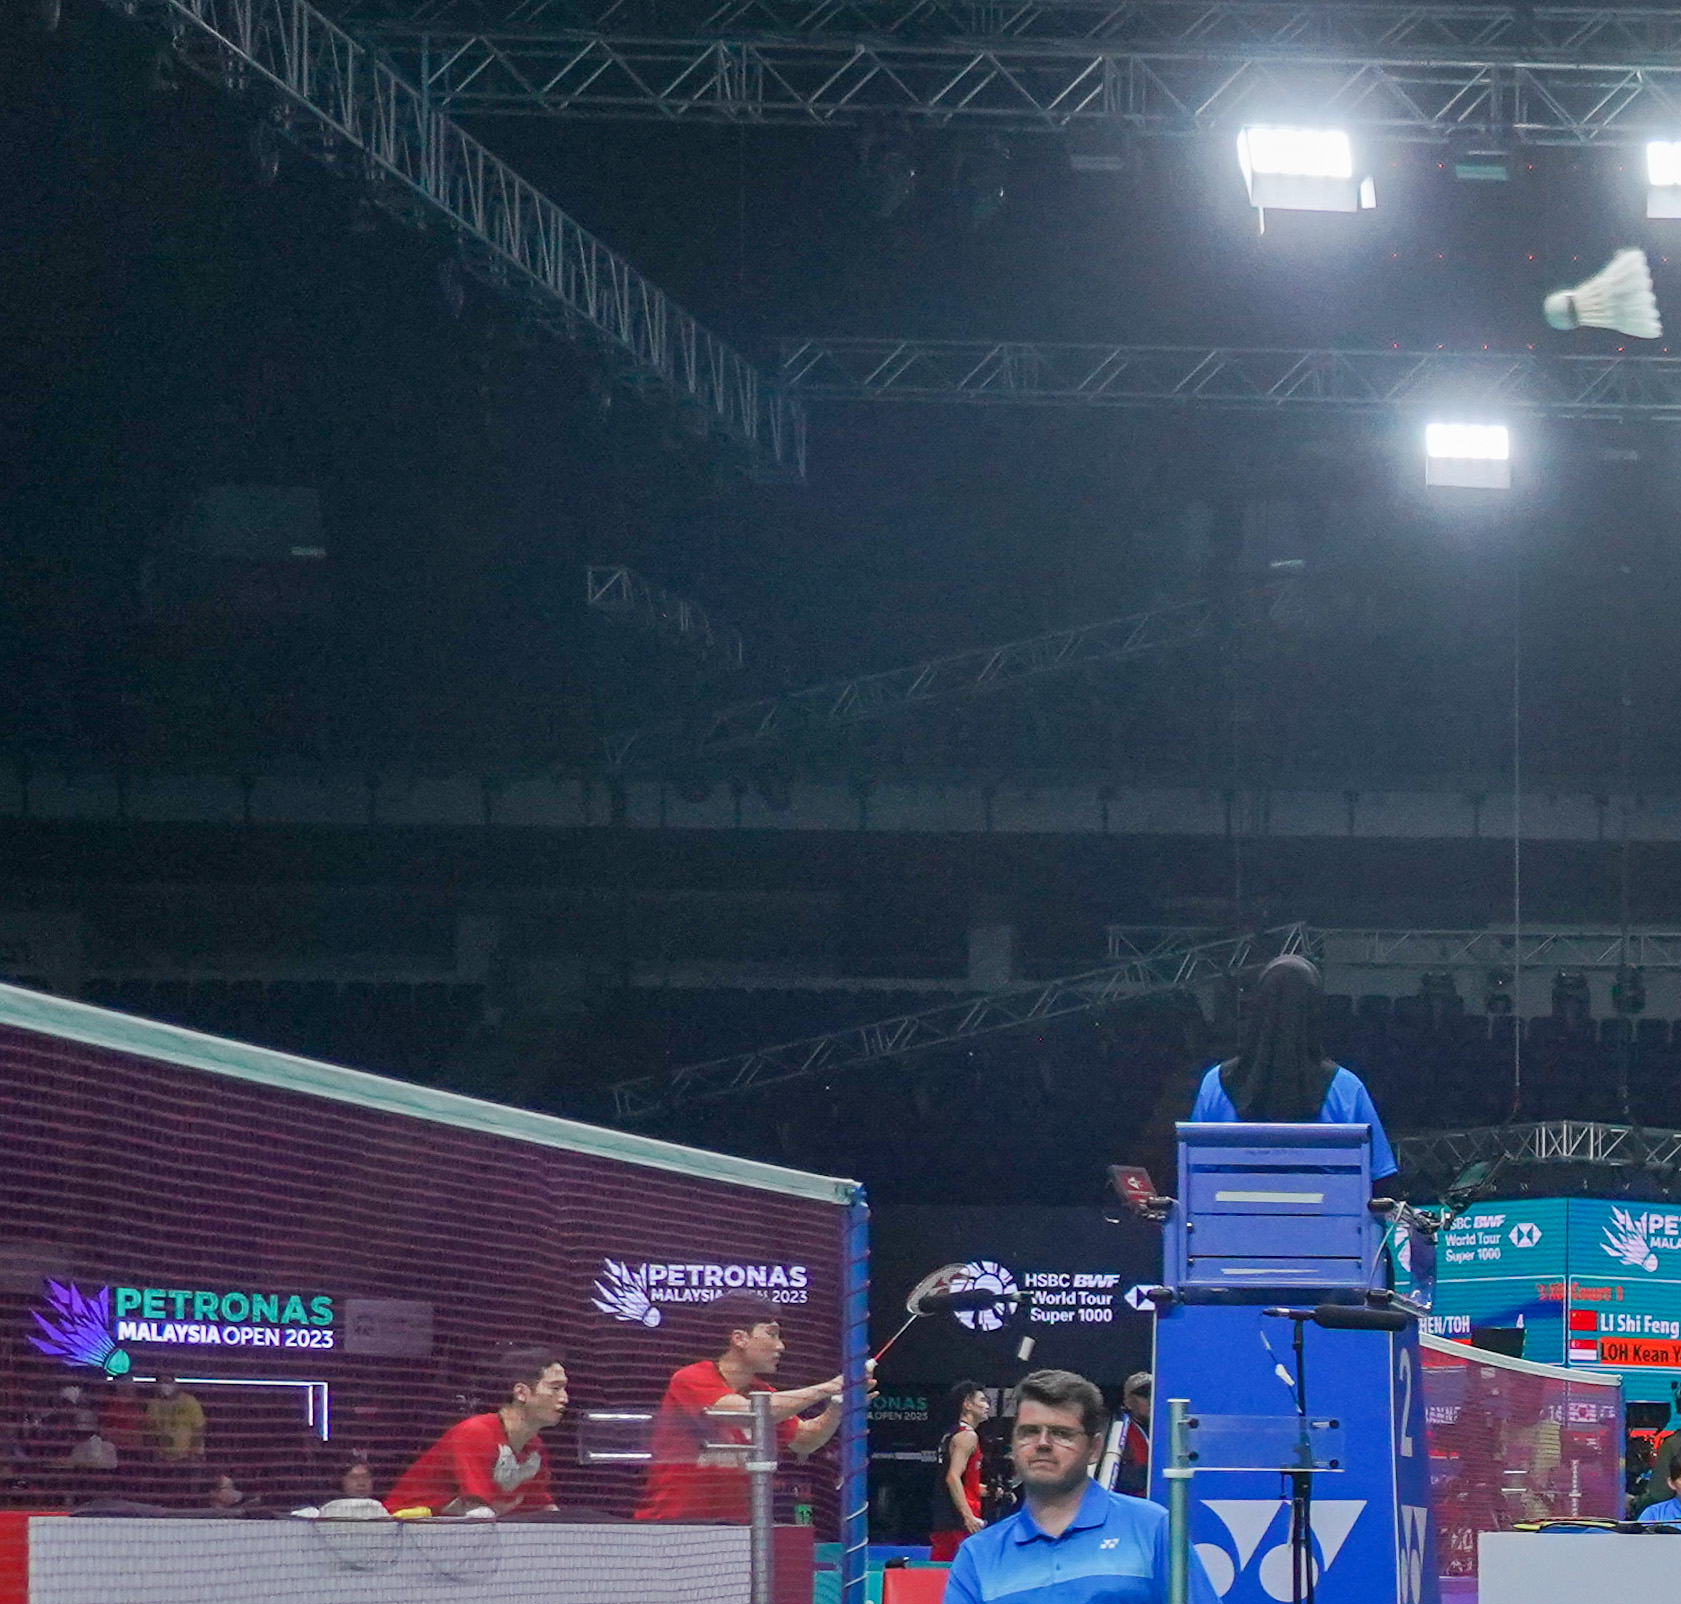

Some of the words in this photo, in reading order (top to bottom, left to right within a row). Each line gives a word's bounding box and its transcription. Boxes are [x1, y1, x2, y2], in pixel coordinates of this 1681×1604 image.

[1473, 1214, 1505, 1228] BWF
[1445, 1232, 1475, 1246] World
[1478, 1232, 1501, 1245] Tour
[1445, 1249, 1475, 1264] Super
[1477, 1247, 1501, 1260] 1000
[650, 1264, 808, 1288] PETRONAS
[1024, 1273, 1070, 1288] HSBC
[1073, 1274, 1121, 1288] BWF
[651, 1288, 724, 1302] MALAYSIA
[771, 1290, 808, 1304] 2023
[1079, 1291, 1113, 1306] Tour
[1570, 1282, 1611, 1301] Court
[115, 1287, 334, 1327] PETRONAS
[1030, 1308, 1075, 1324] Super
[1078, 1308, 1113, 1323] 1000
[1516, 1313, 1525, 1328] 4
[1600, 1313, 1614, 1331] LI
[1617, 1314, 1641, 1333] Shi
[1644, 1316, 1680, 1340] Feng
[117, 1321, 221, 1345] MALAYSIA
[222, 1326, 281, 1347] OPEN
[284, 1329, 335, 1349] 2023
[1601, 1342, 1628, 1361] LOH
[1633, 1344, 1668, 1363] Kean
[872, 1395, 928, 1411] ONAS
[1399, 1347, 1413, 1457] 2
[874, 1411, 902, 1420] OPEN
